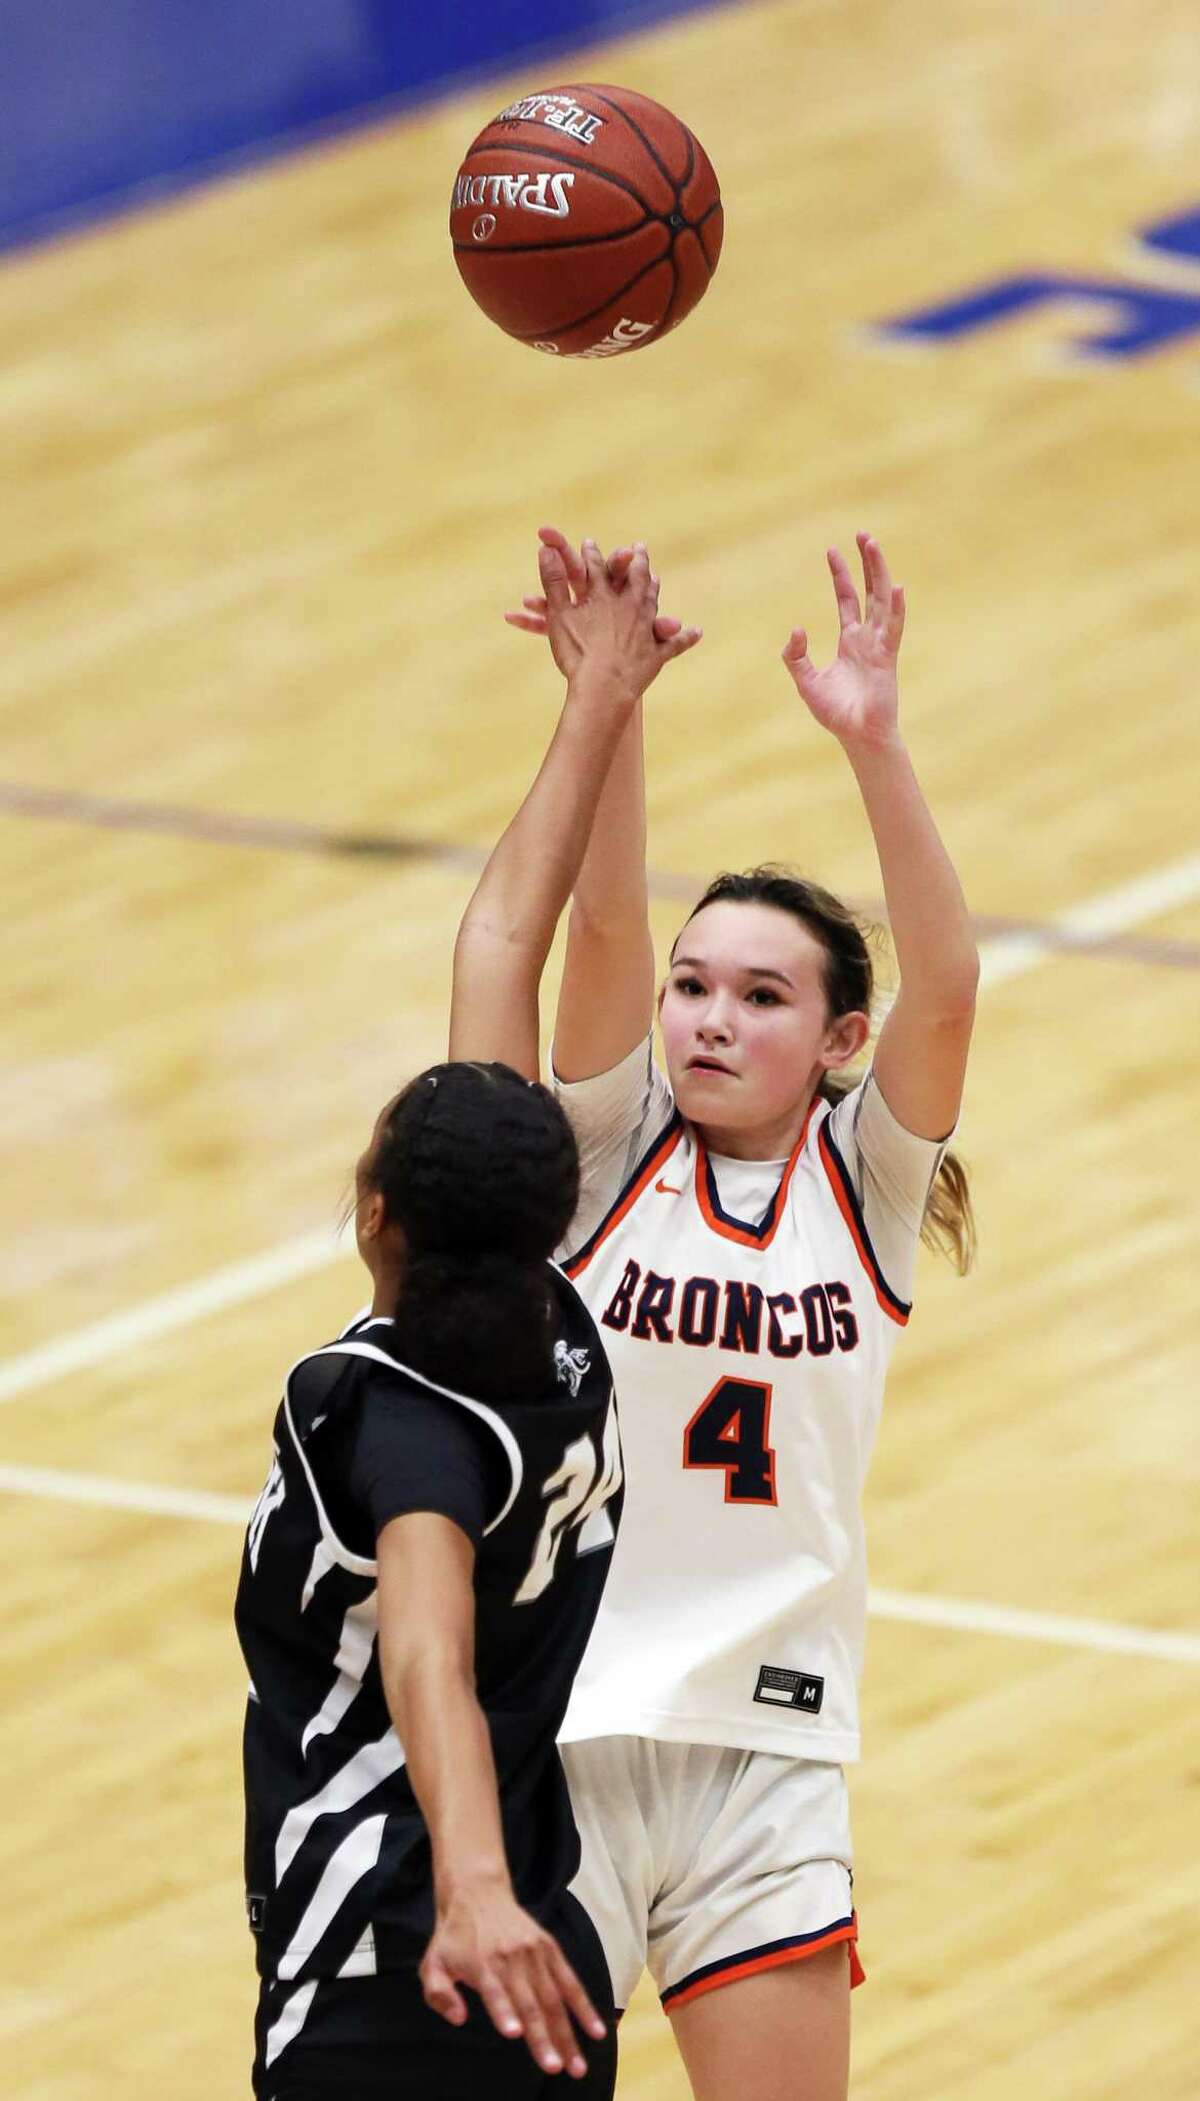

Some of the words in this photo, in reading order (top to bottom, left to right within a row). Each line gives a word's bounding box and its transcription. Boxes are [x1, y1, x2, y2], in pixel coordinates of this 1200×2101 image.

[601, 1258, 859, 1359] BRONCOS
[683, 1375, 778, 1507] 4
[803, 1686, 816, 1702] M
